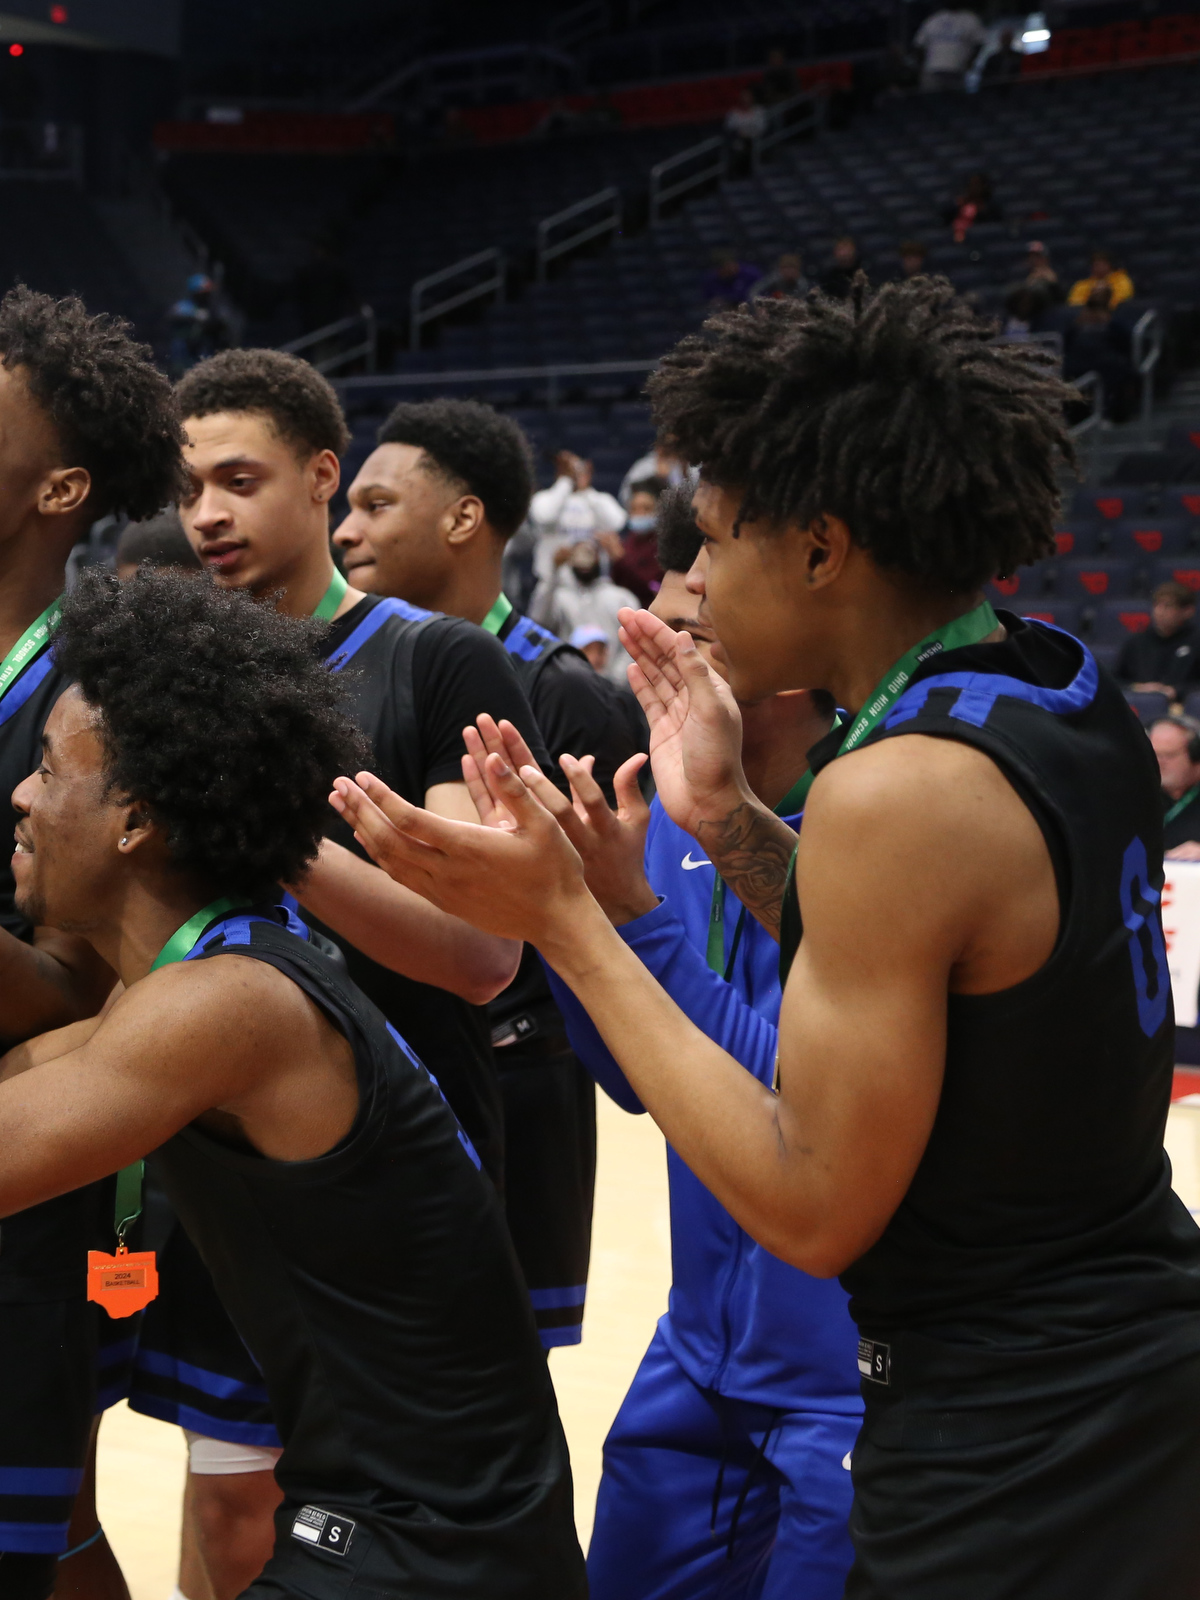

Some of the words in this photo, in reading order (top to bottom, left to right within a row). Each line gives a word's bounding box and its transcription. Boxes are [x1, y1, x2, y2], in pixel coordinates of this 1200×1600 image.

[12, 639, 36, 663] SCHOOL
[887, 671, 909, 694] OHIO
[868, 694, 889, 717] HIGH
[845, 717, 869, 750] SCHOOL
[875, 1354, 883, 1372] S
[328, 1526, 341, 1542] S
